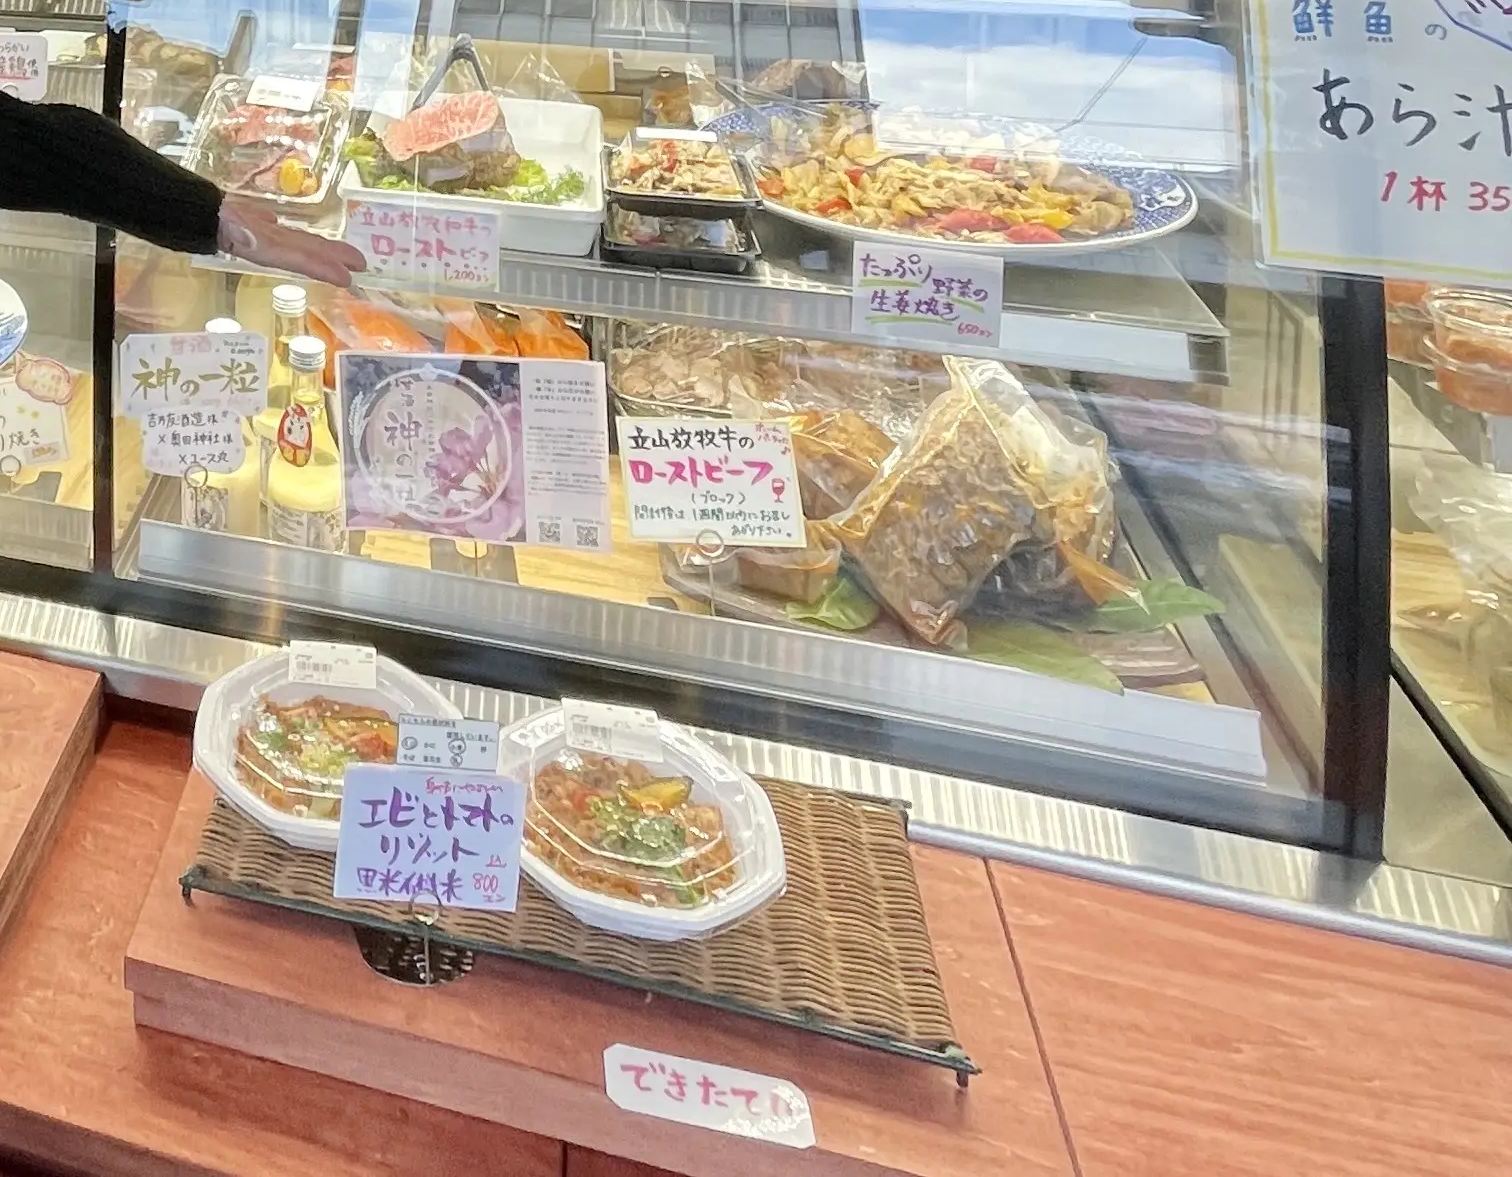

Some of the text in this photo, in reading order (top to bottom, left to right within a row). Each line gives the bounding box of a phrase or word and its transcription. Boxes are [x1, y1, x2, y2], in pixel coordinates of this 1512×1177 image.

[1311, 67, 1512, 158] あら汁
[870, 288, 961, 321] 生姜焼き
[130, 356, 261, 402] 神の一粒
[627, 424, 755, 452] 立山放牧牛の
[627, 454, 774, 489] ローストビーフ
[691, 490, 746, 505] (ブロック)
[357, 785, 515, 833] エビとトマトの
[379, 832, 481, 866] リゾット
[472, 872, 499, 894] 800
